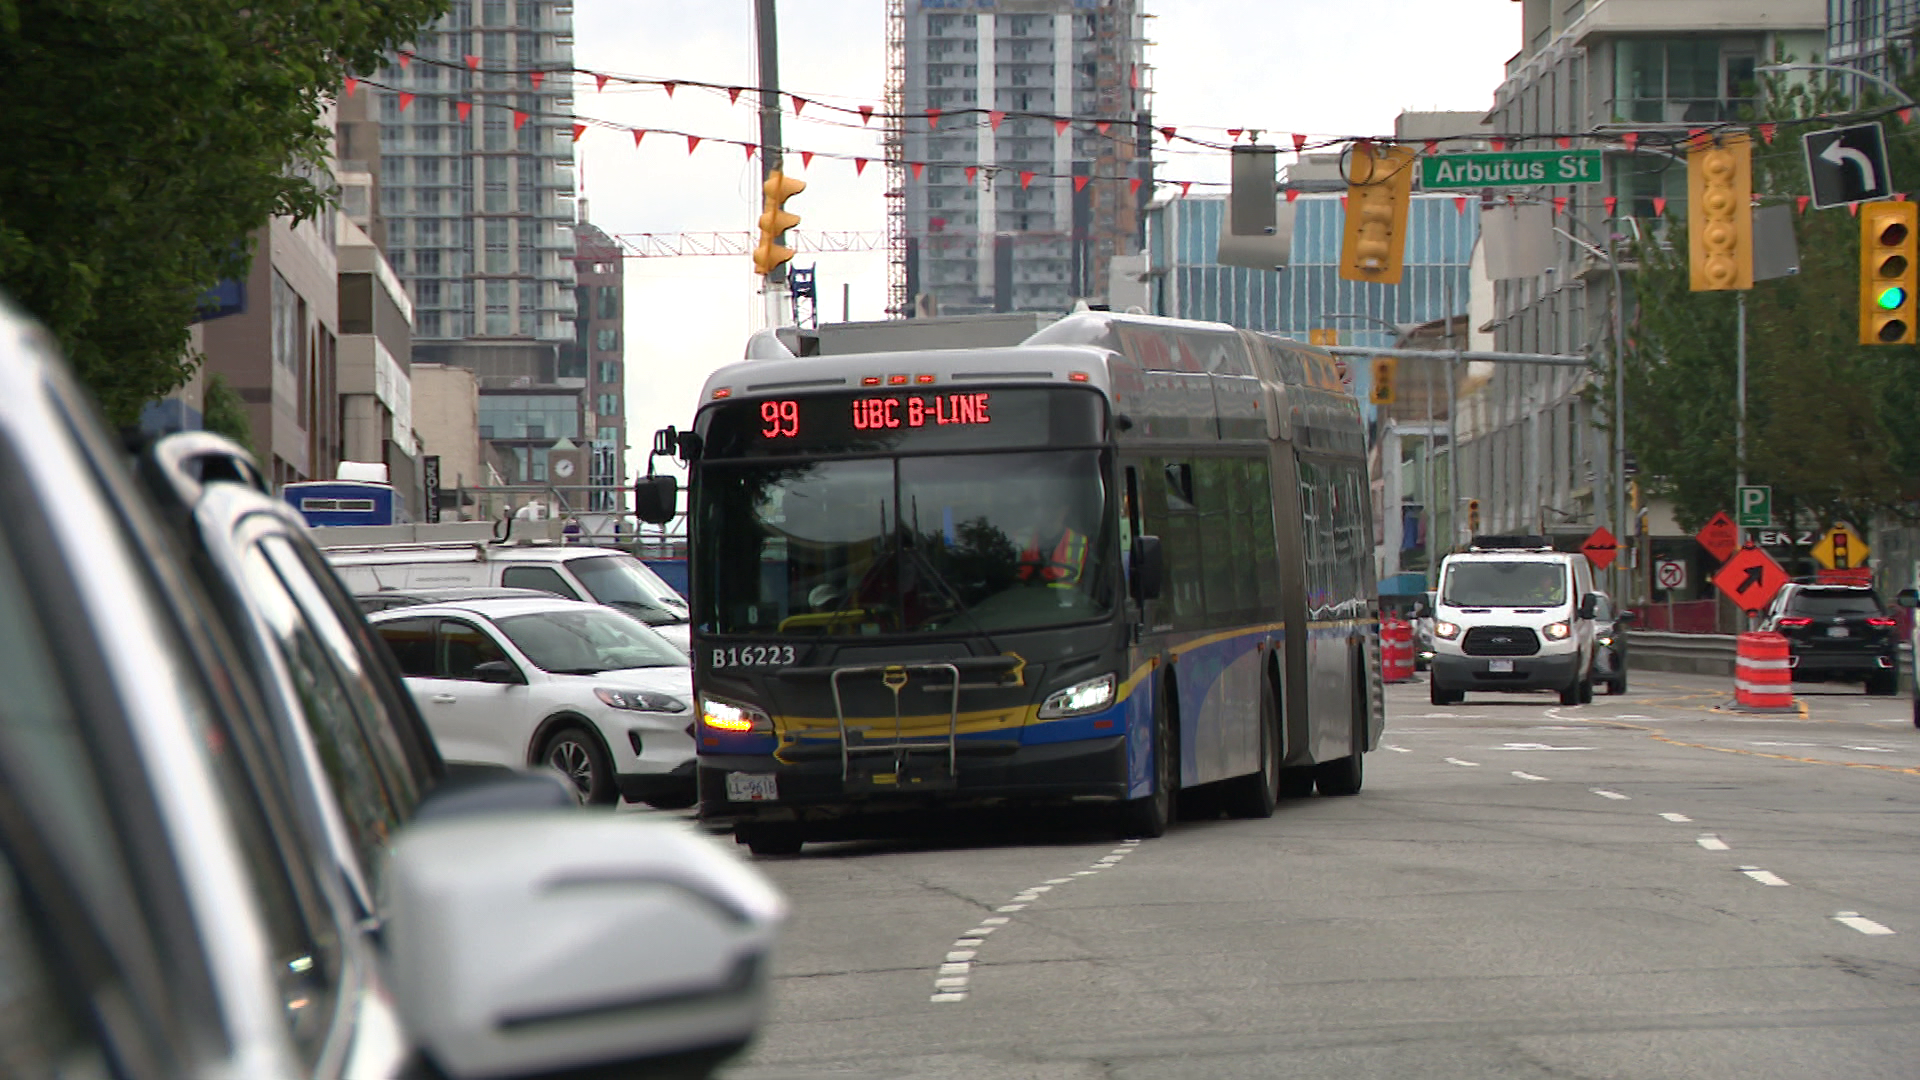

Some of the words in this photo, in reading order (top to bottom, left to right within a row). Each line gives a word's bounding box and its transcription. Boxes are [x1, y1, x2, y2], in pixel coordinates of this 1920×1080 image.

[1435, 159, 1544, 183] Arbutus
[1558, 154, 1588, 179] St
[760, 400, 799, 438] 99
[853, 398, 900, 429] UBC
[907, 392, 990, 428] B-LINE
[1742, 488, 1765, 514] P
[712, 645, 796, 669] B16223
